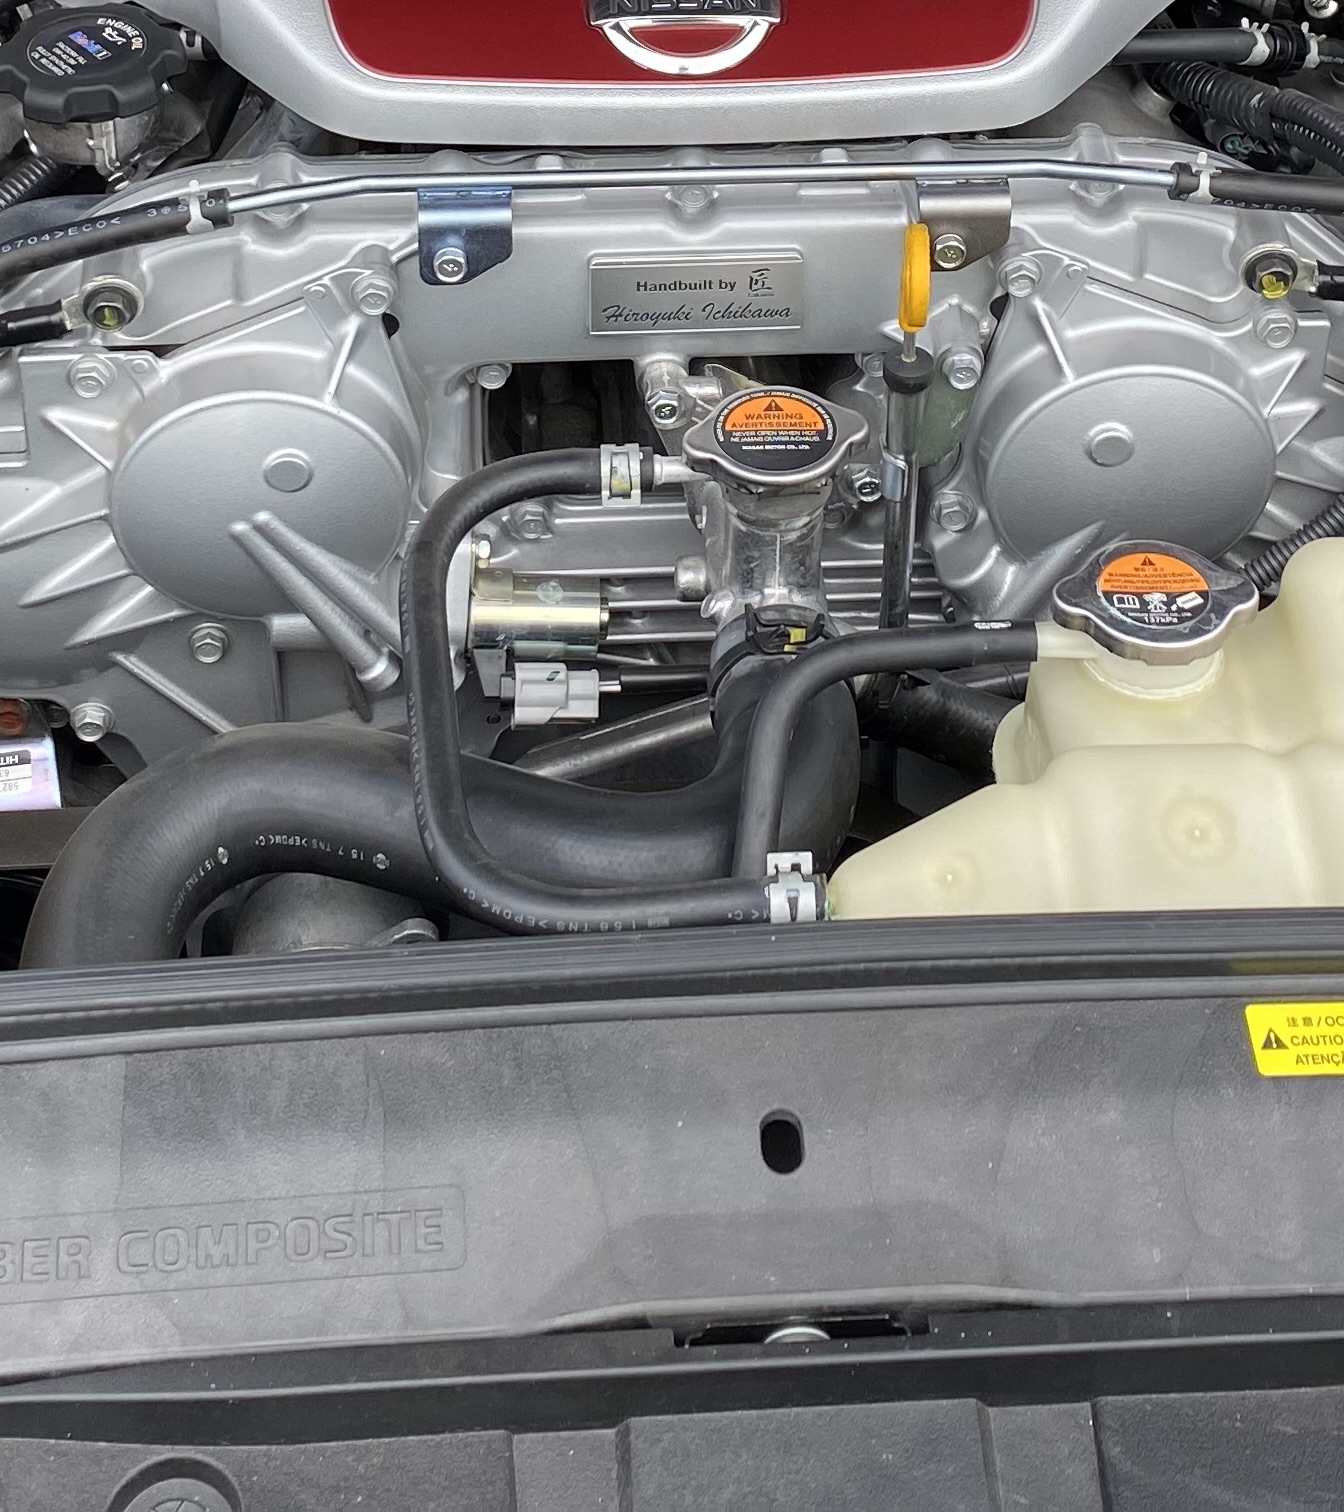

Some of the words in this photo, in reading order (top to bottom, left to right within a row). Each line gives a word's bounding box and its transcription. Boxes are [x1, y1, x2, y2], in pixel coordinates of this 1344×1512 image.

[97, 18, 140, 38] ENGINE
[636, 279, 714, 292] Handbuilt
[718, 279, 737, 293] by
[601, 304, 694, 326] Hiroyuki
[701, 302, 792, 320] Ichikawa
[116, 1207, 445, 1276] COMPOSITE
